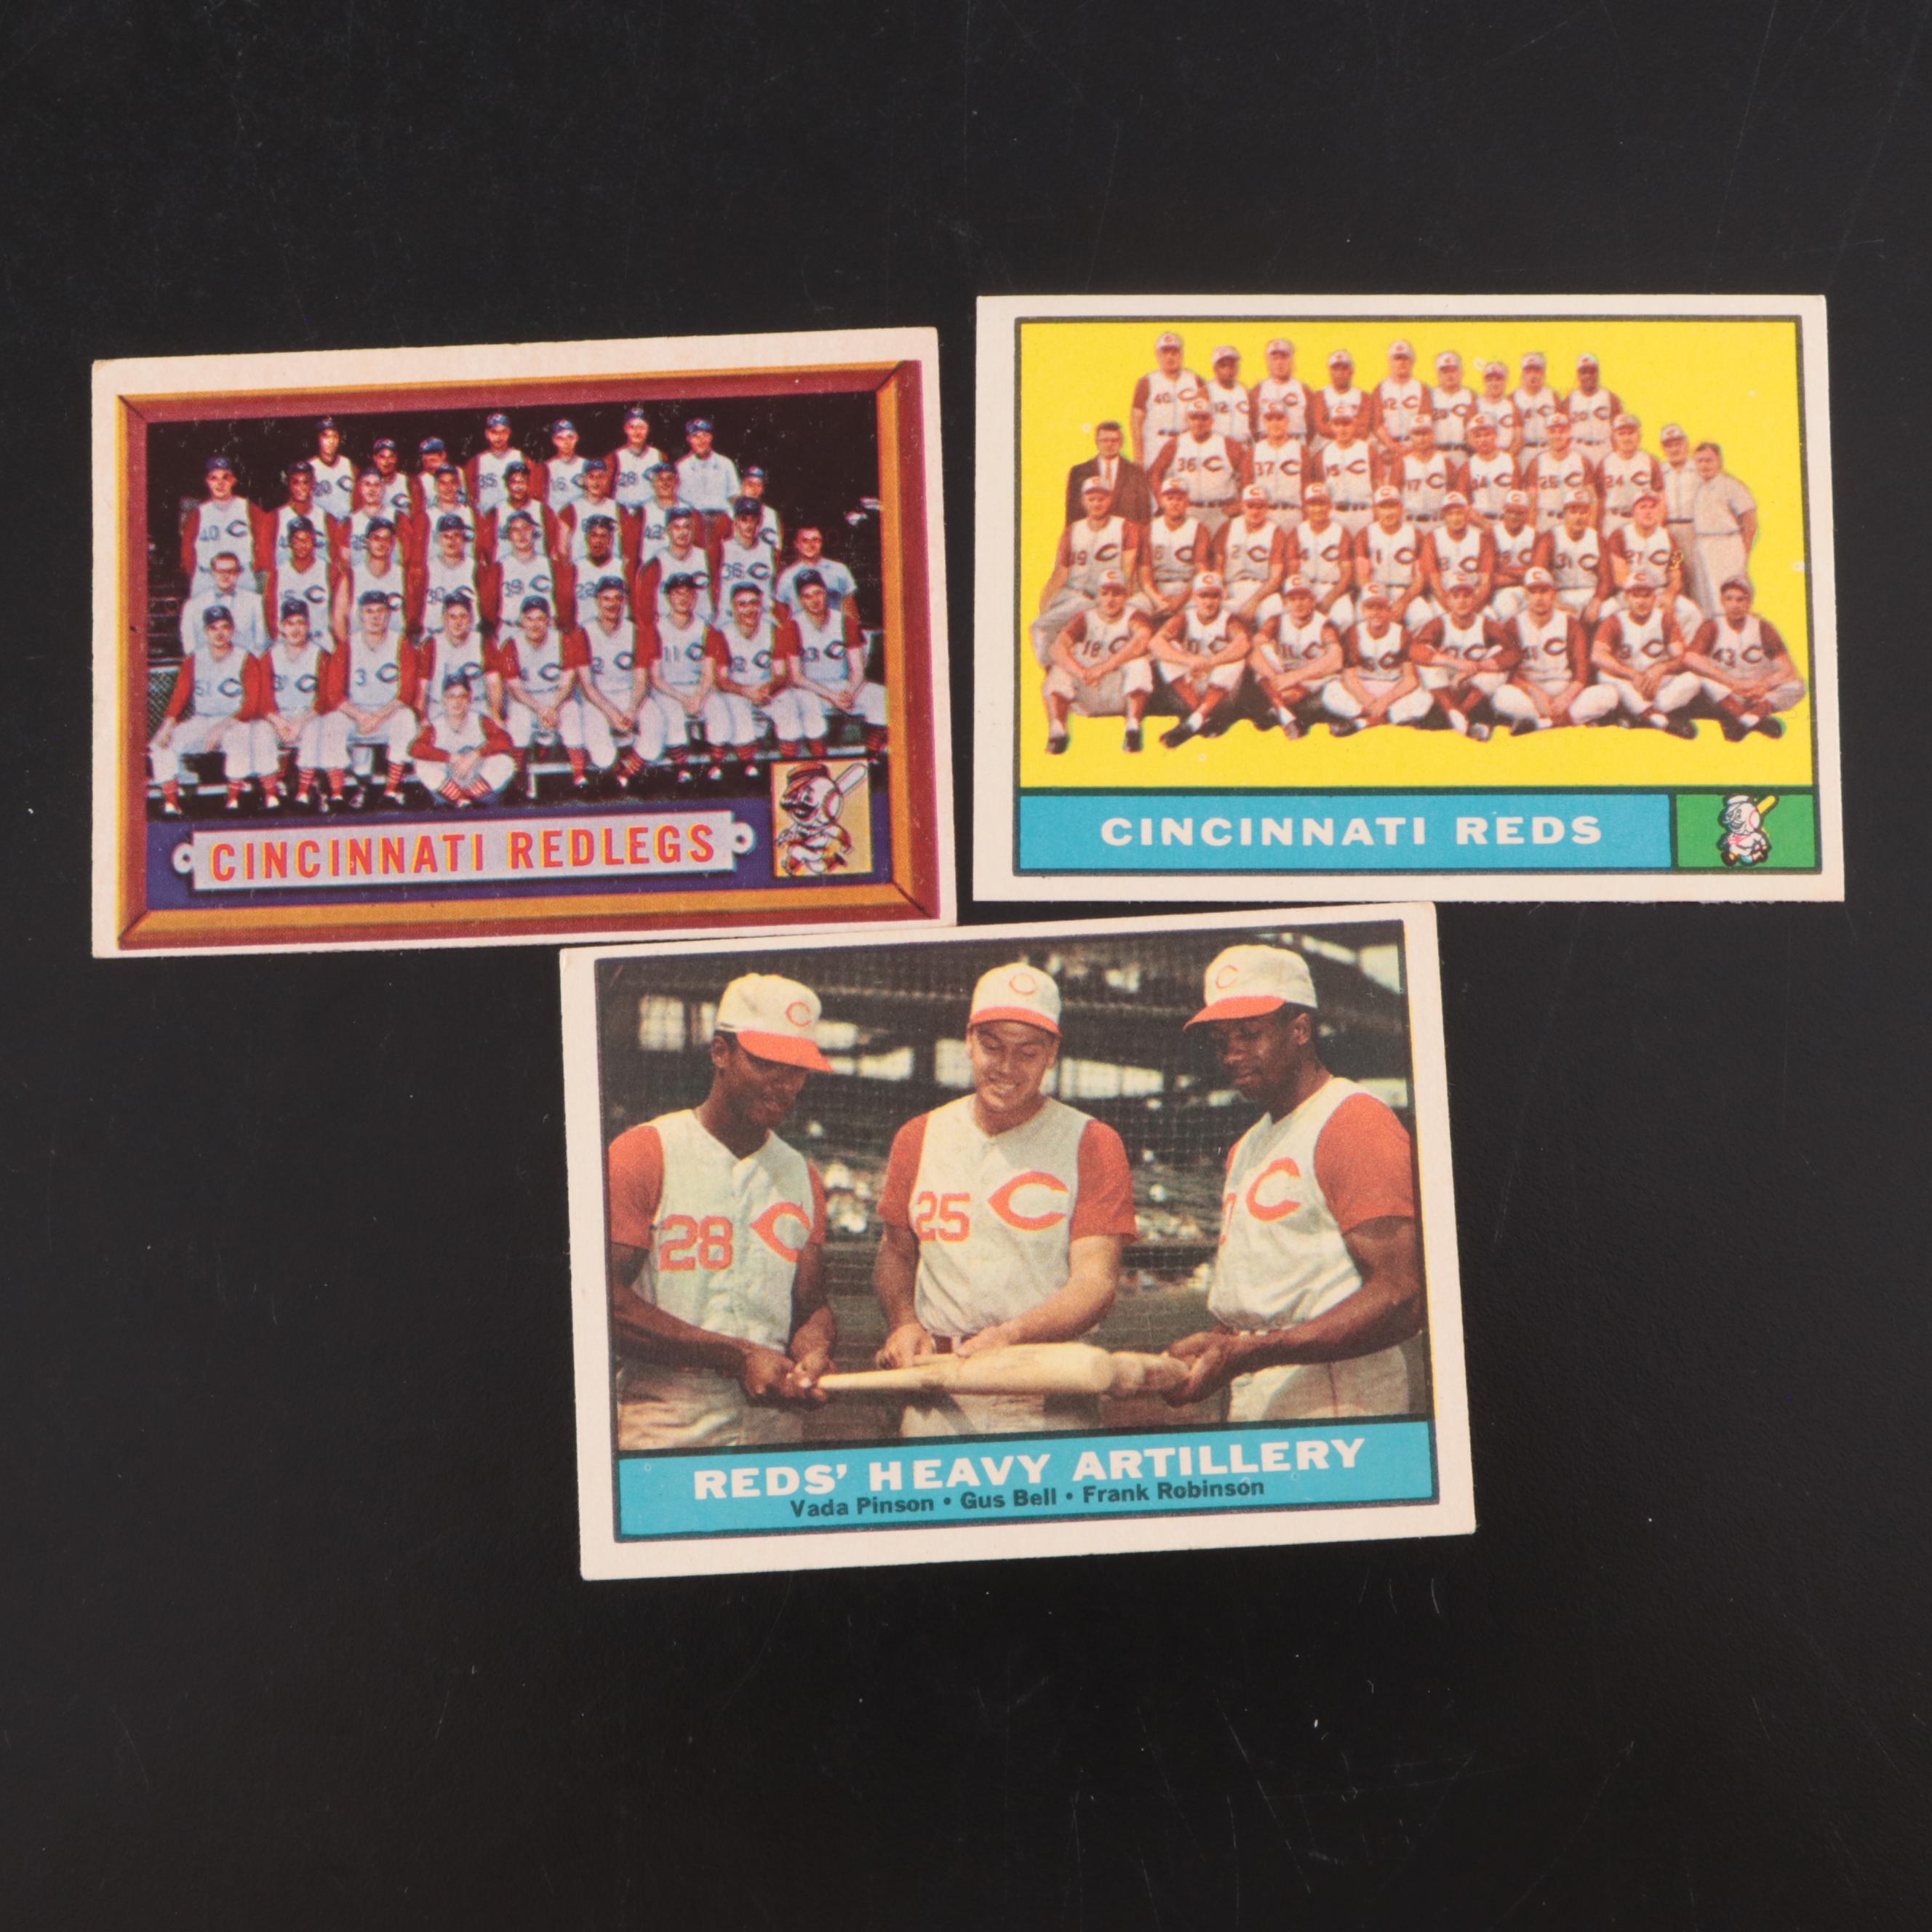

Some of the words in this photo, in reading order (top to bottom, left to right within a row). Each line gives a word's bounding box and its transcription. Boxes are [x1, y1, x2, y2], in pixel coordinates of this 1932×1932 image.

[1178, 388, 1199, 402] C
[1282, 393, 1298, 407] C
[1402, 396, 1419, 409] C
[1452, 404, 1469, 417] C
[1537, 404, 1555, 418] C
[1593, 407, 1610, 420] C
[1499, 415, 1514, 427] C
[1202, 456, 1225, 471] C
[1280, 459, 1301, 475] C
[1347, 459, 1368, 474] C
[337, 475, 354, 492] C
[1426, 474, 1447, 490] C
[1493, 474, 1513, 487] C
[1565, 473, 1585, 488] C
[1630, 471, 1651, 486] C
[391, 492, 409, 508] C
[225, 519, 248, 538] C
[759, 527, 778, 545] C
[1095, 543, 1119, 562] C
[1175, 546, 1194, 562] C
[1248, 546, 1269, 562] C
[1321, 546, 1341, 562] C
[1394, 547, 1418, 564] C
[1578, 553, 1599, 570] C
[1648, 548, 1671, 565] C
[746, 562, 770, 580] C
[1459, 556, 1479, 572] C
[529, 574, 551, 593] C
[303, 584, 327, 604] C
[685, 642, 706, 662] C
[823, 640, 847, 660] C
[1109, 636, 1129, 654] C
[1544, 637, 1567, 655] C
[1641, 639, 1666, 658] C
[1741, 645, 1763, 663] C
[612, 651, 635, 671] C
[752, 650, 773, 669] C
[375, 663, 399, 683] C
[458, 661, 482, 681] C
[538, 663, 561, 682] C
[219, 676, 244, 698] C
[295, 673, 318, 693] C
[1101, 817, 1426, 847] CINCINNATI
[1456, 815, 1602, 845] REDS
[209, 834, 484, 882] CINCINNATI
[507, 823, 715, 869] REDLEGS
[1008, 973, 1037, 996] C
[1216, 965, 1239, 989] C
[785, 1001, 812, 1028] C
[1245, 1157, 1301, 1222] C
[915, 1191, 971, 1243] 25
[988, 1171, 1070, 1231] C
[658, 1213, 734, 1272] 28
[750, 1202, 811, 1264] C
[694, 1464, 847, 1500] REDS'
[869, 1454, 1051, 1490] HEAVY
[1072, 1437, 1365, 1482] ARTILLERY
[790, 1499, 850, 1518] Vada
[856, 1496, 935, 1514] Pinson
[960, 1492, 1006, 1510] Gus
[1013, 1488, 1057, 1507] Bell
[1082, 1484, 1150, 1504] Frank
[1157, 1480, 1265, 1500] Robinson
